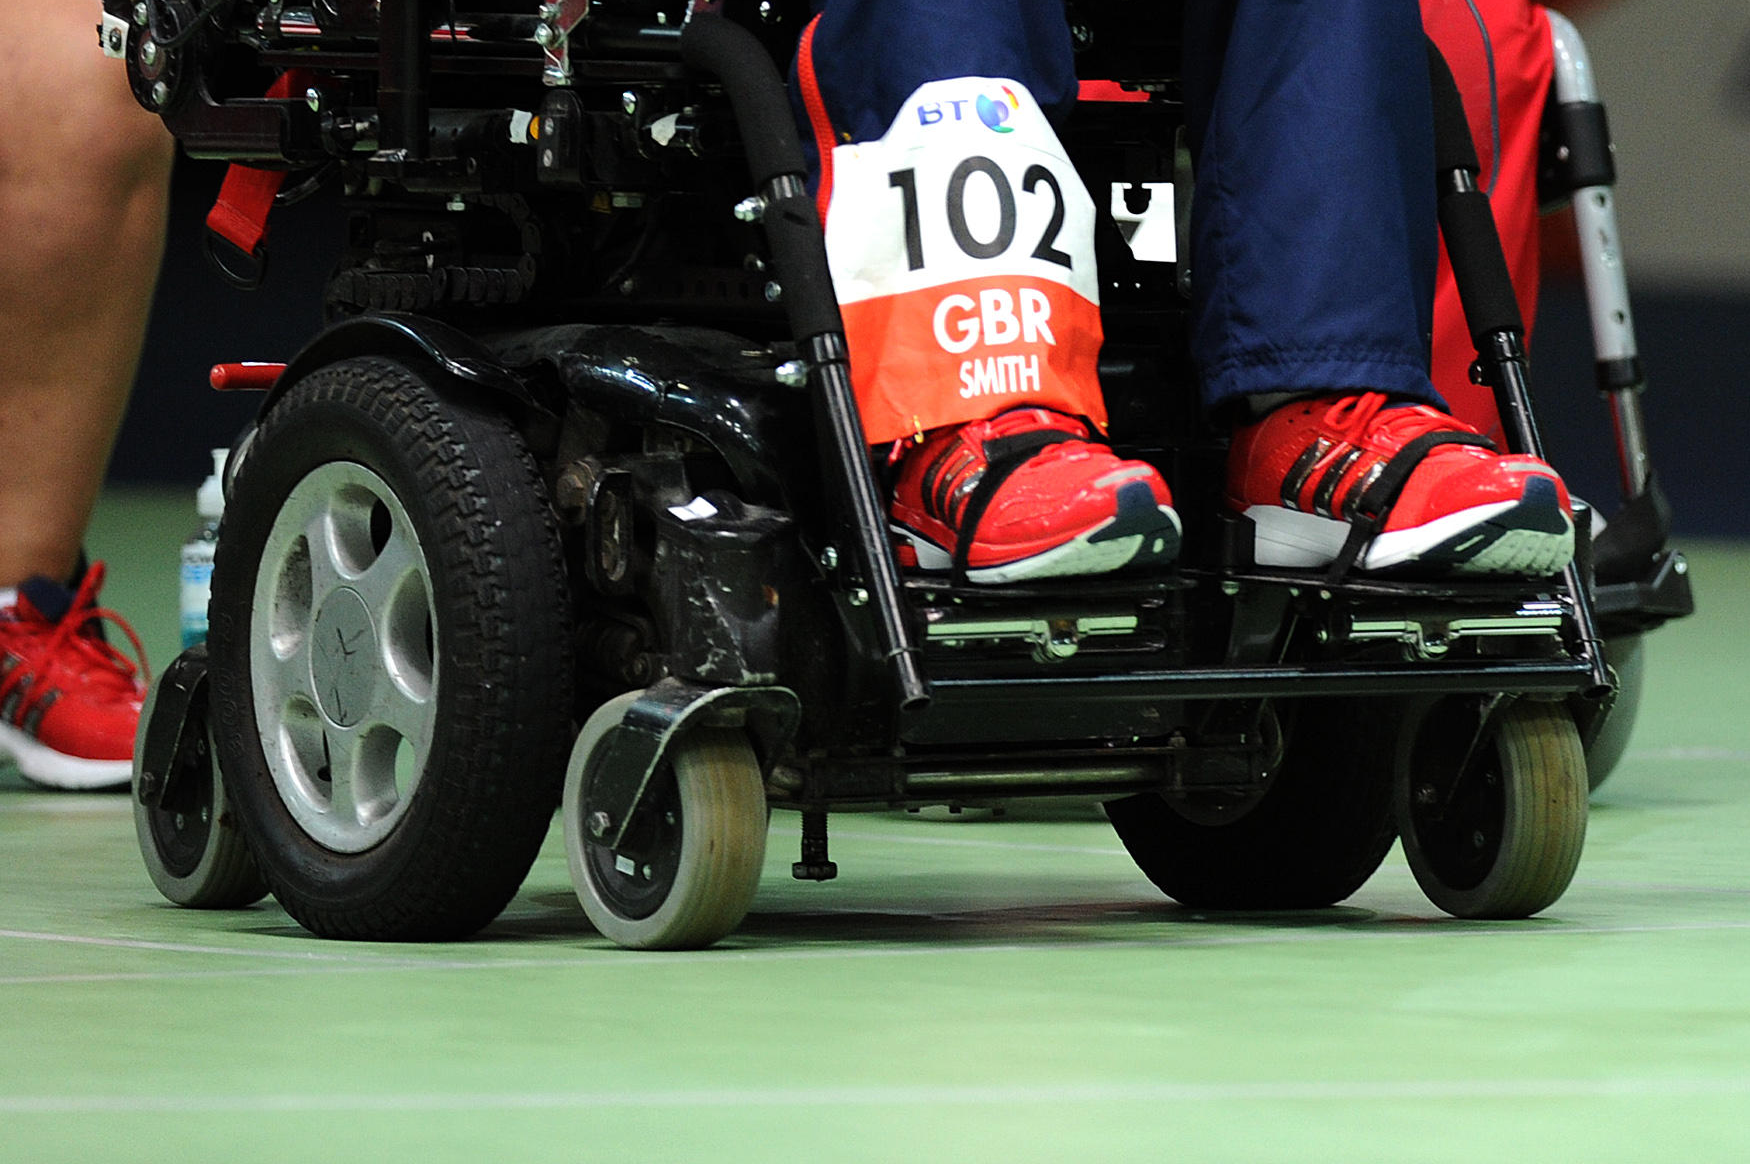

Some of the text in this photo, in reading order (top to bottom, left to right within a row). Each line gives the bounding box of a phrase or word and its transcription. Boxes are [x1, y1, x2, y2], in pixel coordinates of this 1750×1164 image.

[917, 99, 969, 126] BT
[889, 155, 1073, 272] 102
[933, 288, 1056, 354] GBR
[959, 355, 1041, 399] SMITH
